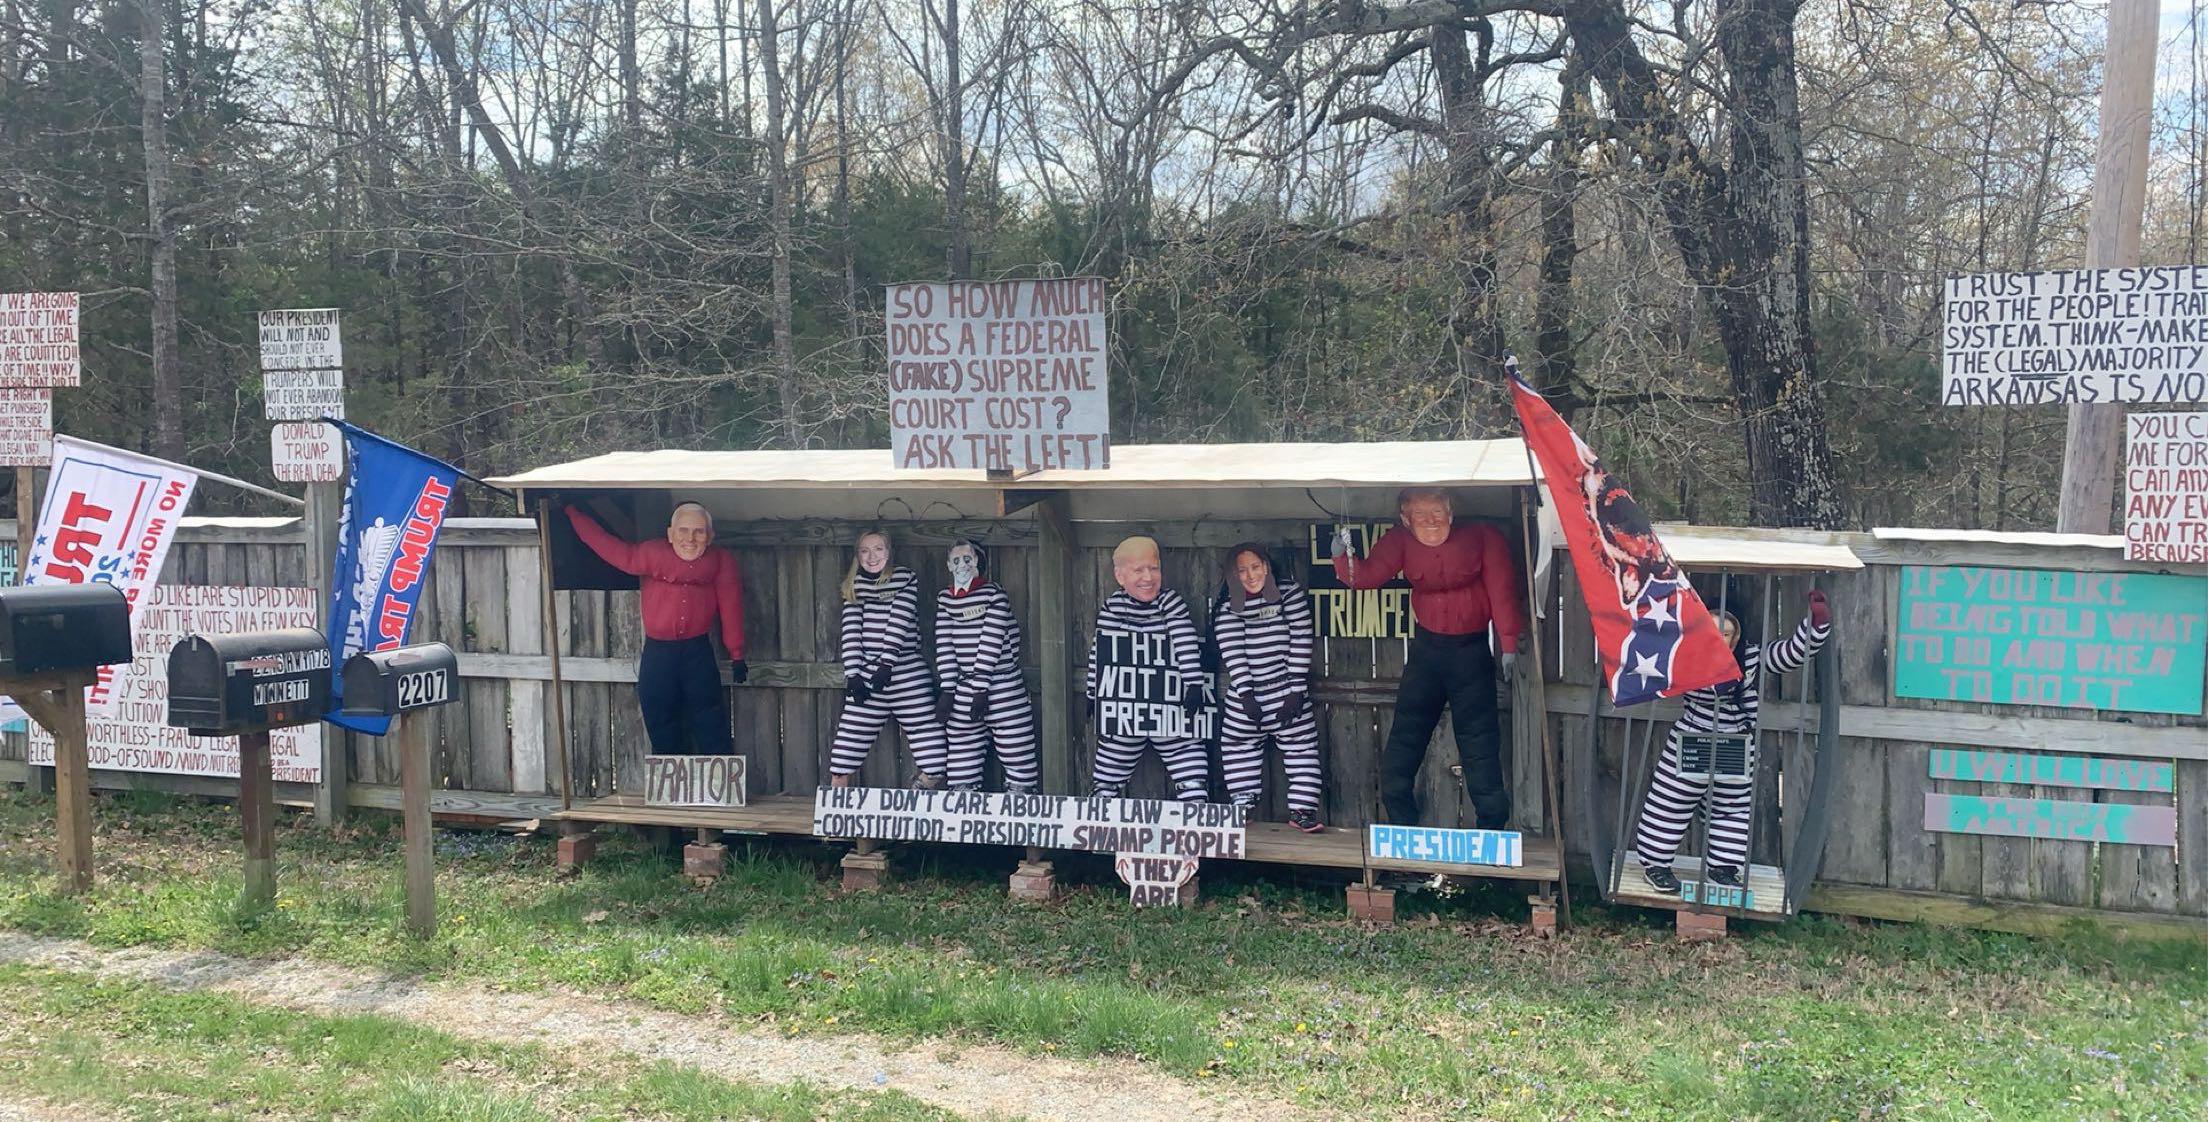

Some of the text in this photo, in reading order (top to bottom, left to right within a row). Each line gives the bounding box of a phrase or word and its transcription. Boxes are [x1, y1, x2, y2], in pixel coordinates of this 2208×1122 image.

[1947, 265, 2208, 297] TRUST THE SYSTE
[8, 293, 25, 309] WE
[893, 279, 1104, 319] SO HOW MUCH
[1948, 294, 2148, 324] FOR THE PEOPLE!
[30, 311, 42, 326] OF
[261, 310, 337, 326] OUR PRESIDENT
[10, 327, 76, 343] ALL THE LEGAL
[261, 327, 329, 342] WILL NOT AND
[891, 320, 1099, 355] DOES A FEDERAL
[1946, 324, 2048, 348] SYSTEM.
[5, 346, 22, 361] ARE
[306, 343, 325, 354] EVER
[319, 355, 334, 367] THE
[1947, 346, 2203, 374] THE (LEGAL) MAJORITY
[50, 363, 74, 376] WHY
[317, 371, 337, 387] WILL
[889, 357, 1096, 393] (FAKE) SUPREME
[1945, 373, 2208, 406] ARKANSAS IS NO
[267, 405, 286, 419] OUR
[891, 397, 975, 430] COURT
[282, 422, 325, 440] DONALD
[2132, 416, 2178, 439] YOU
[285, 442, 329, 460] TRUMP
[904, 434, 955, 469] ASK
[963, 434, 1013, 470] THE
[2128, 442, 2159, 466] ME
[2128, 495, 2178, 518] ANY
[2127, 522, 2170, 544] CAN
[167, 588, 194, 606] LIKE
[202, 588, 225, 606] ARE
[230, 588, 282, 607] STUPID
[1908, 567, 2129, 605] IF YOU LIKE
[174, 609, 194, 632] THE
[198, 611, 232, 633] VOTES
[1309, 588, 1415, 638] TRUMPE
[1910, 602, 2199, 642] BEING TOLD WHAT
[1900, 634, 2176, 676] TO DO AND WHEN
[400, 671, 447, 707] 2207
[1098, 665, 1157, 699] NOT
[1941, 668, 2134, 712] TO DO IT
[646, 757, 744, 804] TRAITOR
[2081, 757, 2169, 792] LOVE
[818, 786, 868, 810] THEY
[880, 788, 938, 813] DON'T
[943, 791, 992, 815] CARE
[1000, 793, 1068, 820] ABOUT
[1074, 797, 1111, 822] THE
[1072, 825, 1241, 858] SWAMP PEOPLE
[1375, 827, 1519, 866] PRESIDENT
[1131, 857, 1182, 882] THEY
[1132, 885, 1178, 906] ARE
